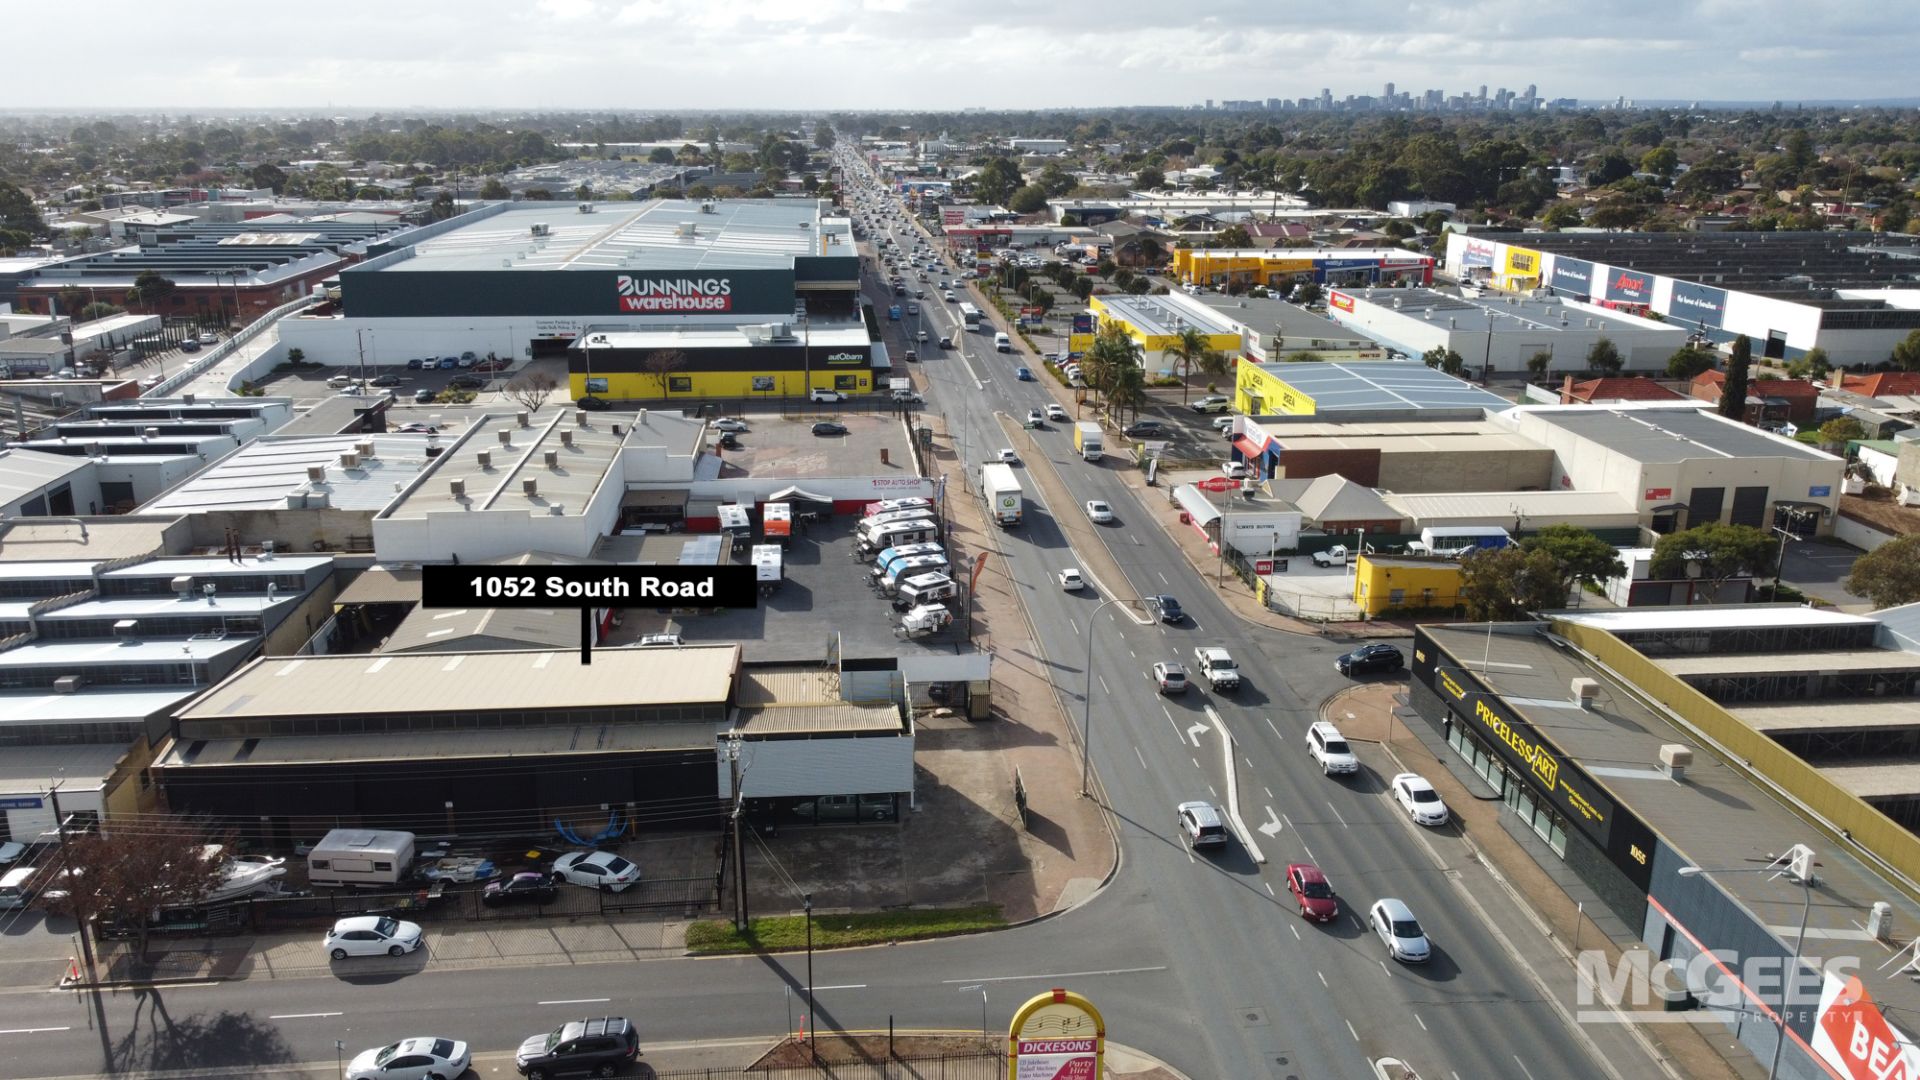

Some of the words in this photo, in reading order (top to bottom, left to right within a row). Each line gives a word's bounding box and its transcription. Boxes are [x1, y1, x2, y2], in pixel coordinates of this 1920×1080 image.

[617, 275, 731, 296] BUNNINGS
[1615, 272, 1645, 291] Amart
[626, 292, 725, 310] warehouse
[1476, 700, 1533, 764] PRICELESS
[1630, 844, 1647, 865] 1055
[1023, 1041, 1092, 1053] DICKESONS
[1069, 1060, 1093, 1069] Party
